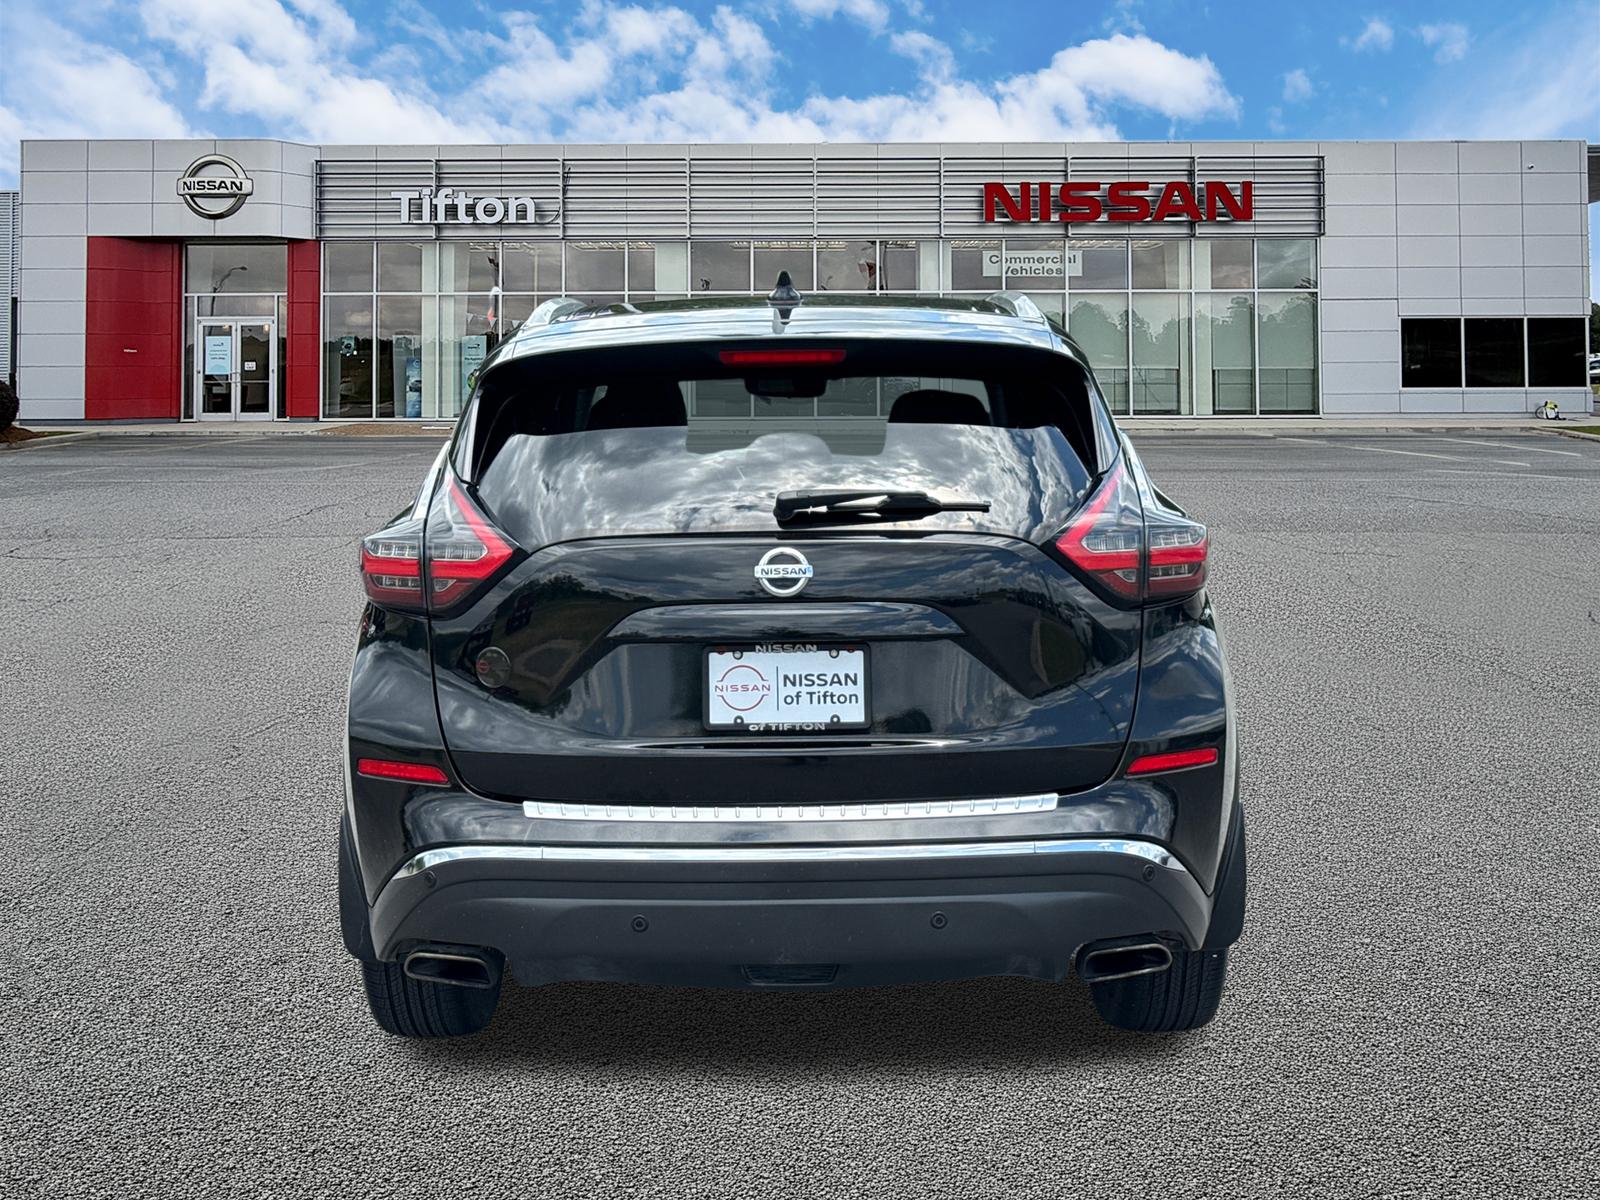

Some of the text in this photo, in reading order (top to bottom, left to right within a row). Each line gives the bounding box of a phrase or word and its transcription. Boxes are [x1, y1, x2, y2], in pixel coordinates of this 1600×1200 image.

[183, 181, 243, 191] NISSAN
[391, 188, 536, 223] Tifton
[984, 181, 1253, 222] NISSAN
[760, 567, 807, 575] NISSAN
[755, 644, 818, 653] NISSAN
[783, 672, 858, 687] NISSAN
[714, 684, 771, 693] NISSAN
[783, 690, 859, 705] of Tifton
[768, 722, 826, 732] TIFTON
